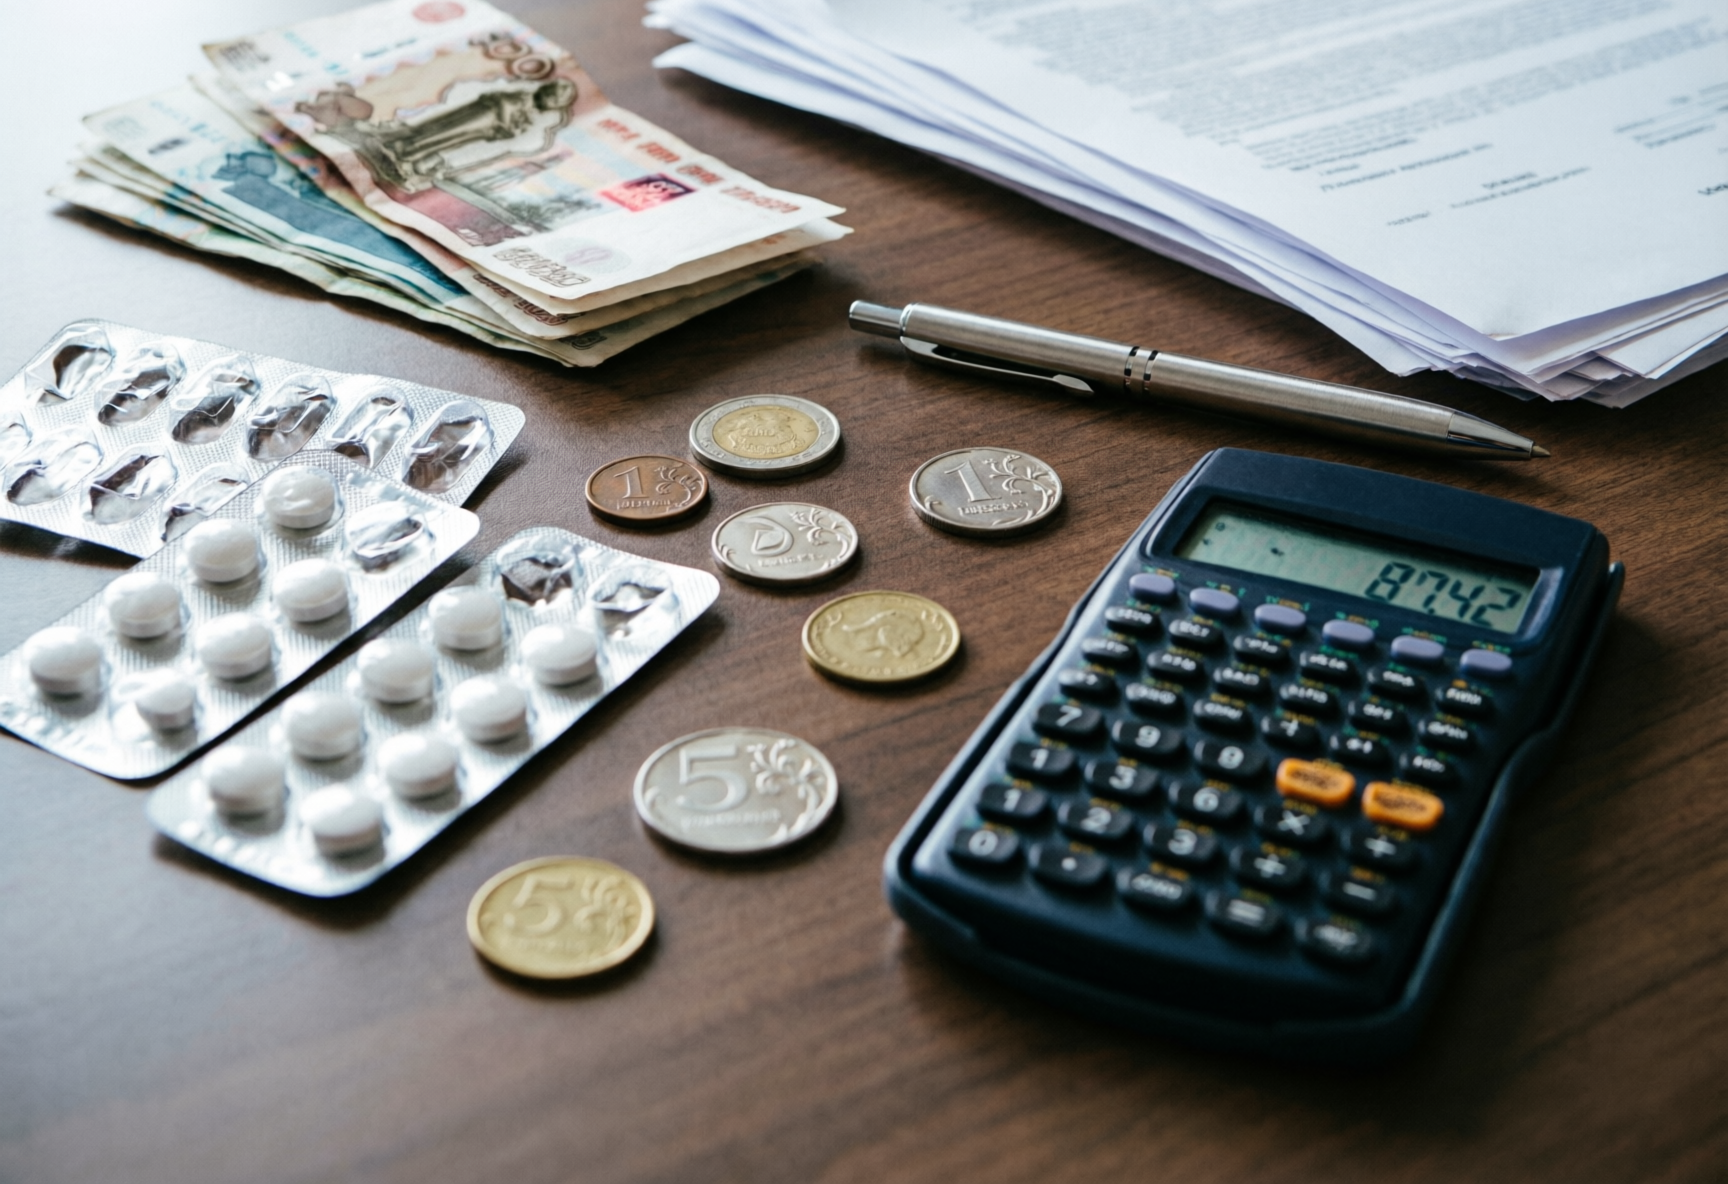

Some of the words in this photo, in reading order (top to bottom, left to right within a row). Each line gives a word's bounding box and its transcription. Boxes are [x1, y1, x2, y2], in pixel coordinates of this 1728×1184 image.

[613, 466, 649, 499] 1
[944, 460, 1002, 503] 1
[1363, 560, 1522, 628] 87.42
[678, 742, 748, 813] 5
[968, 829, 999, 858] 0
[503, 872, 573, 937] 5
